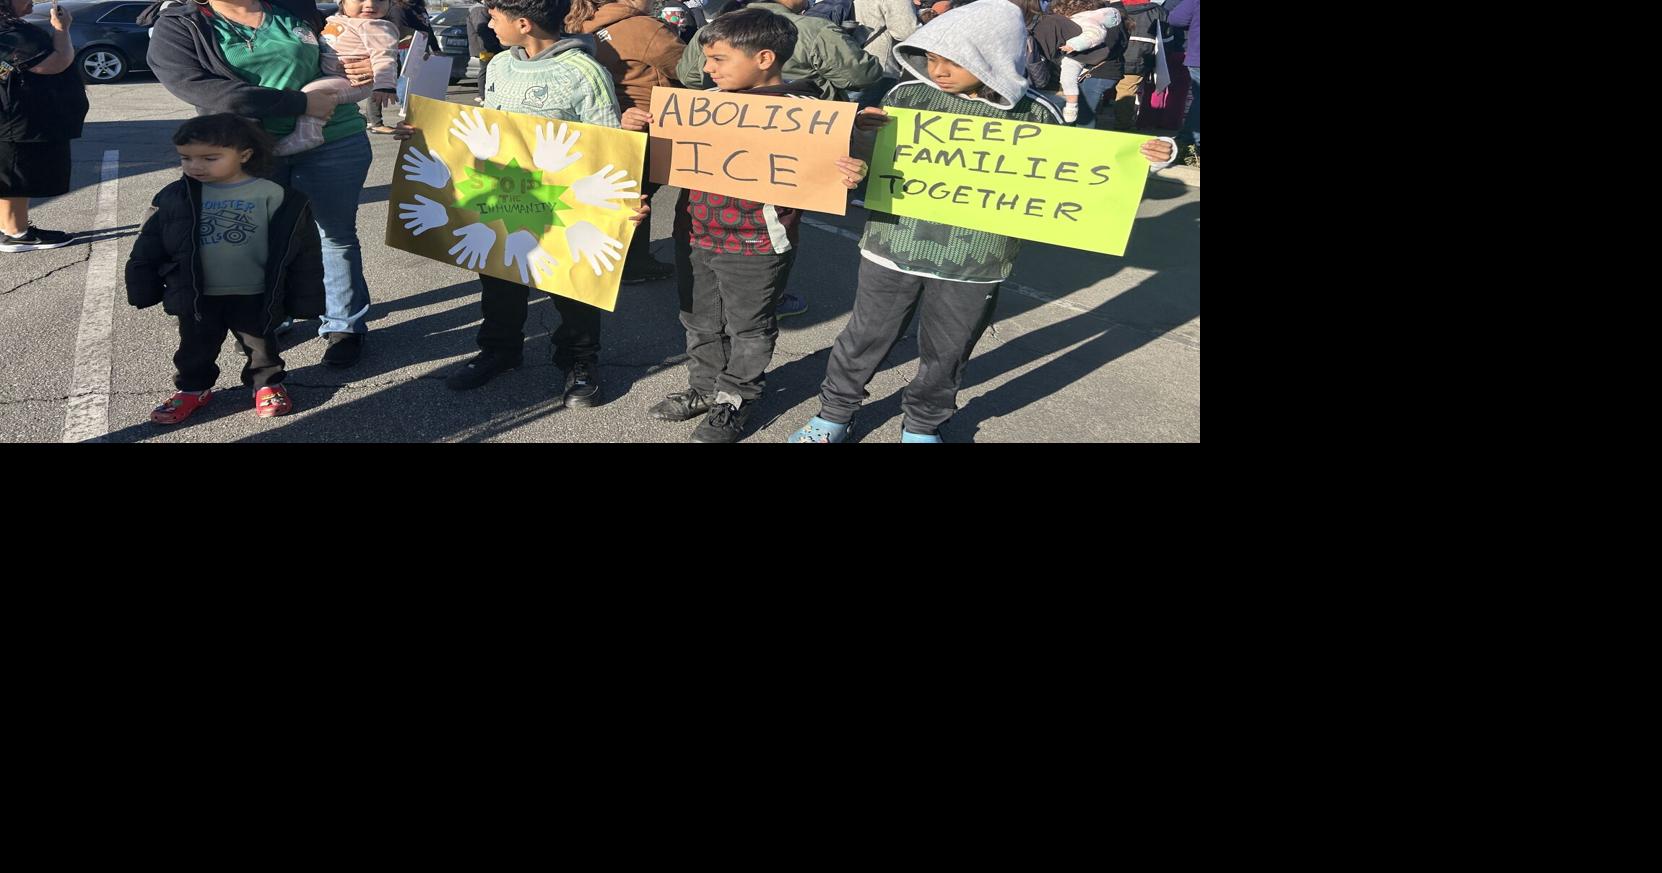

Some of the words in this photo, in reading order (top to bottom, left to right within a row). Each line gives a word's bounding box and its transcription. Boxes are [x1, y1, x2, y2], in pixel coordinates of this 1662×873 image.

[659, 92, 839, 135] ABOLISH
[913, 112, 1042, 145] KEEP
[676, 141, 799, 187] ICE
[893, 144, 1111, 185] FAMILIES
[201, 199, 256, 213] ONSTER
[476, 201, 557, 215] INHUMANITY
[880, 174, 1083, 221] TOGETHER
